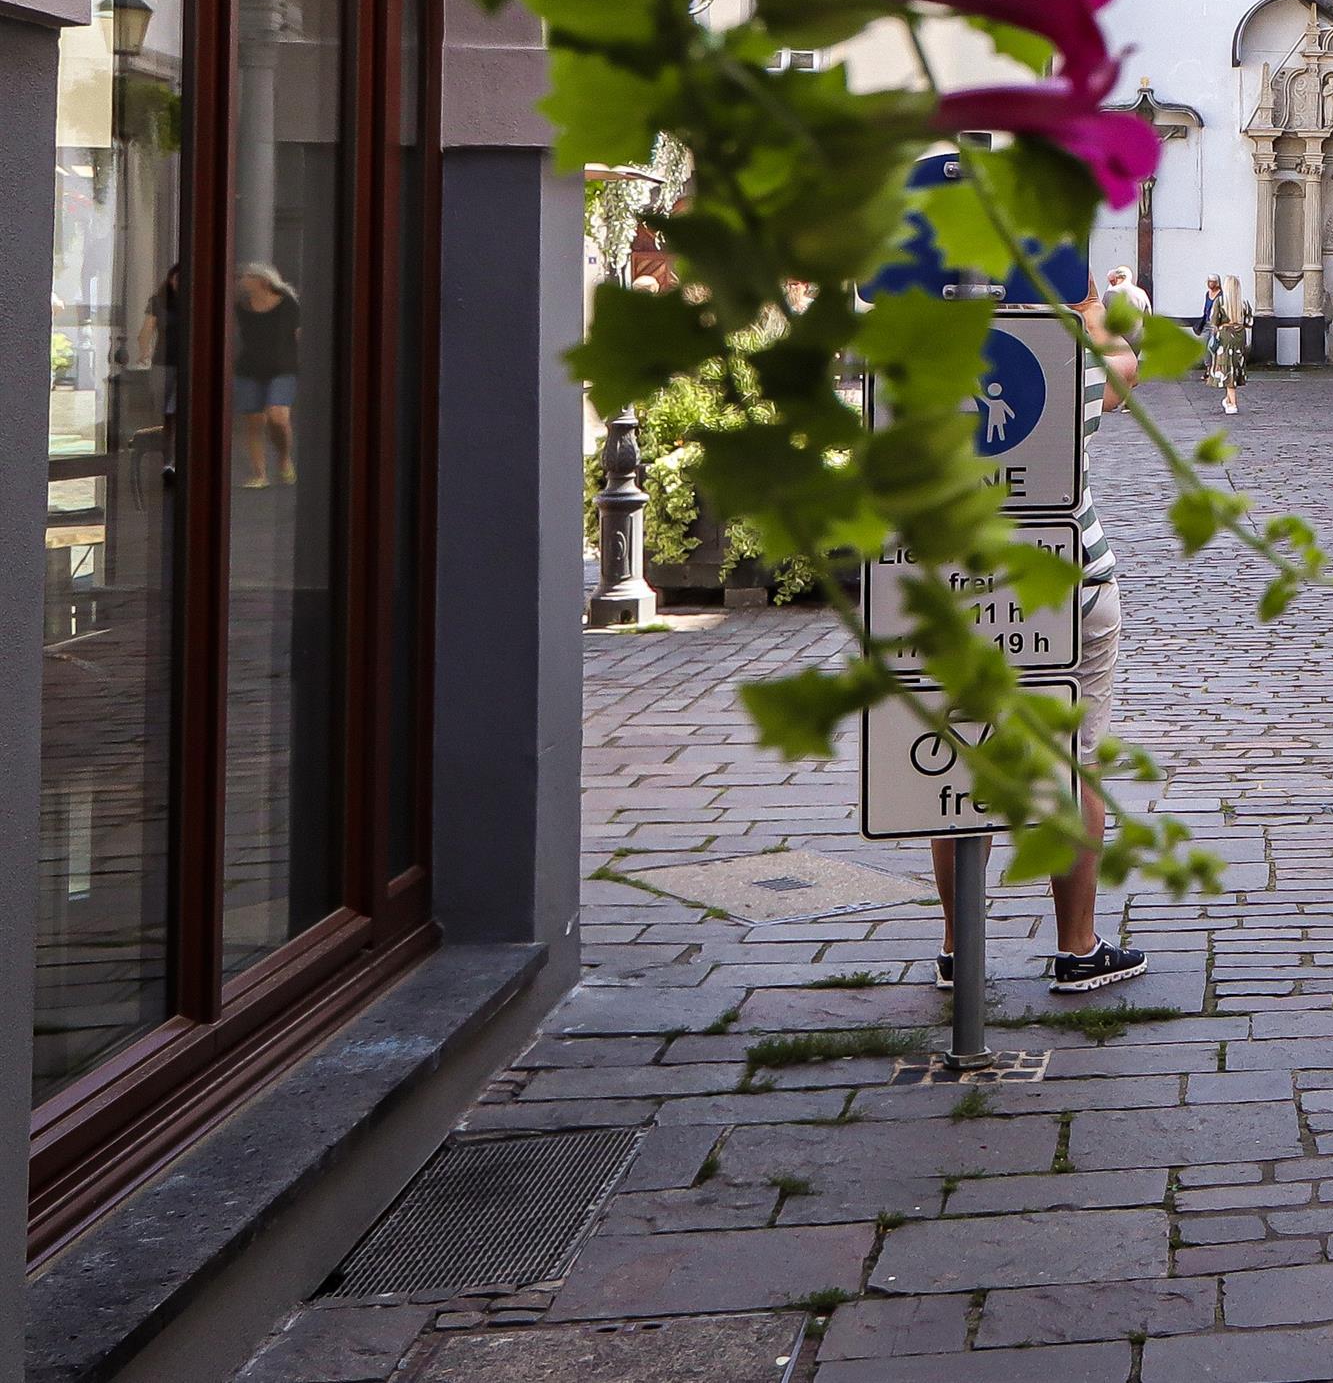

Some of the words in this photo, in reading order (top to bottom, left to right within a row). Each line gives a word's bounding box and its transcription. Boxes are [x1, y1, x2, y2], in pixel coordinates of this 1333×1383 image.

[949, 573, 994, 593] frei
[1009, 602, 1025, 623] h
[994, 633, 1023, 654] 19
[1034, 632, 1049, 653] h
